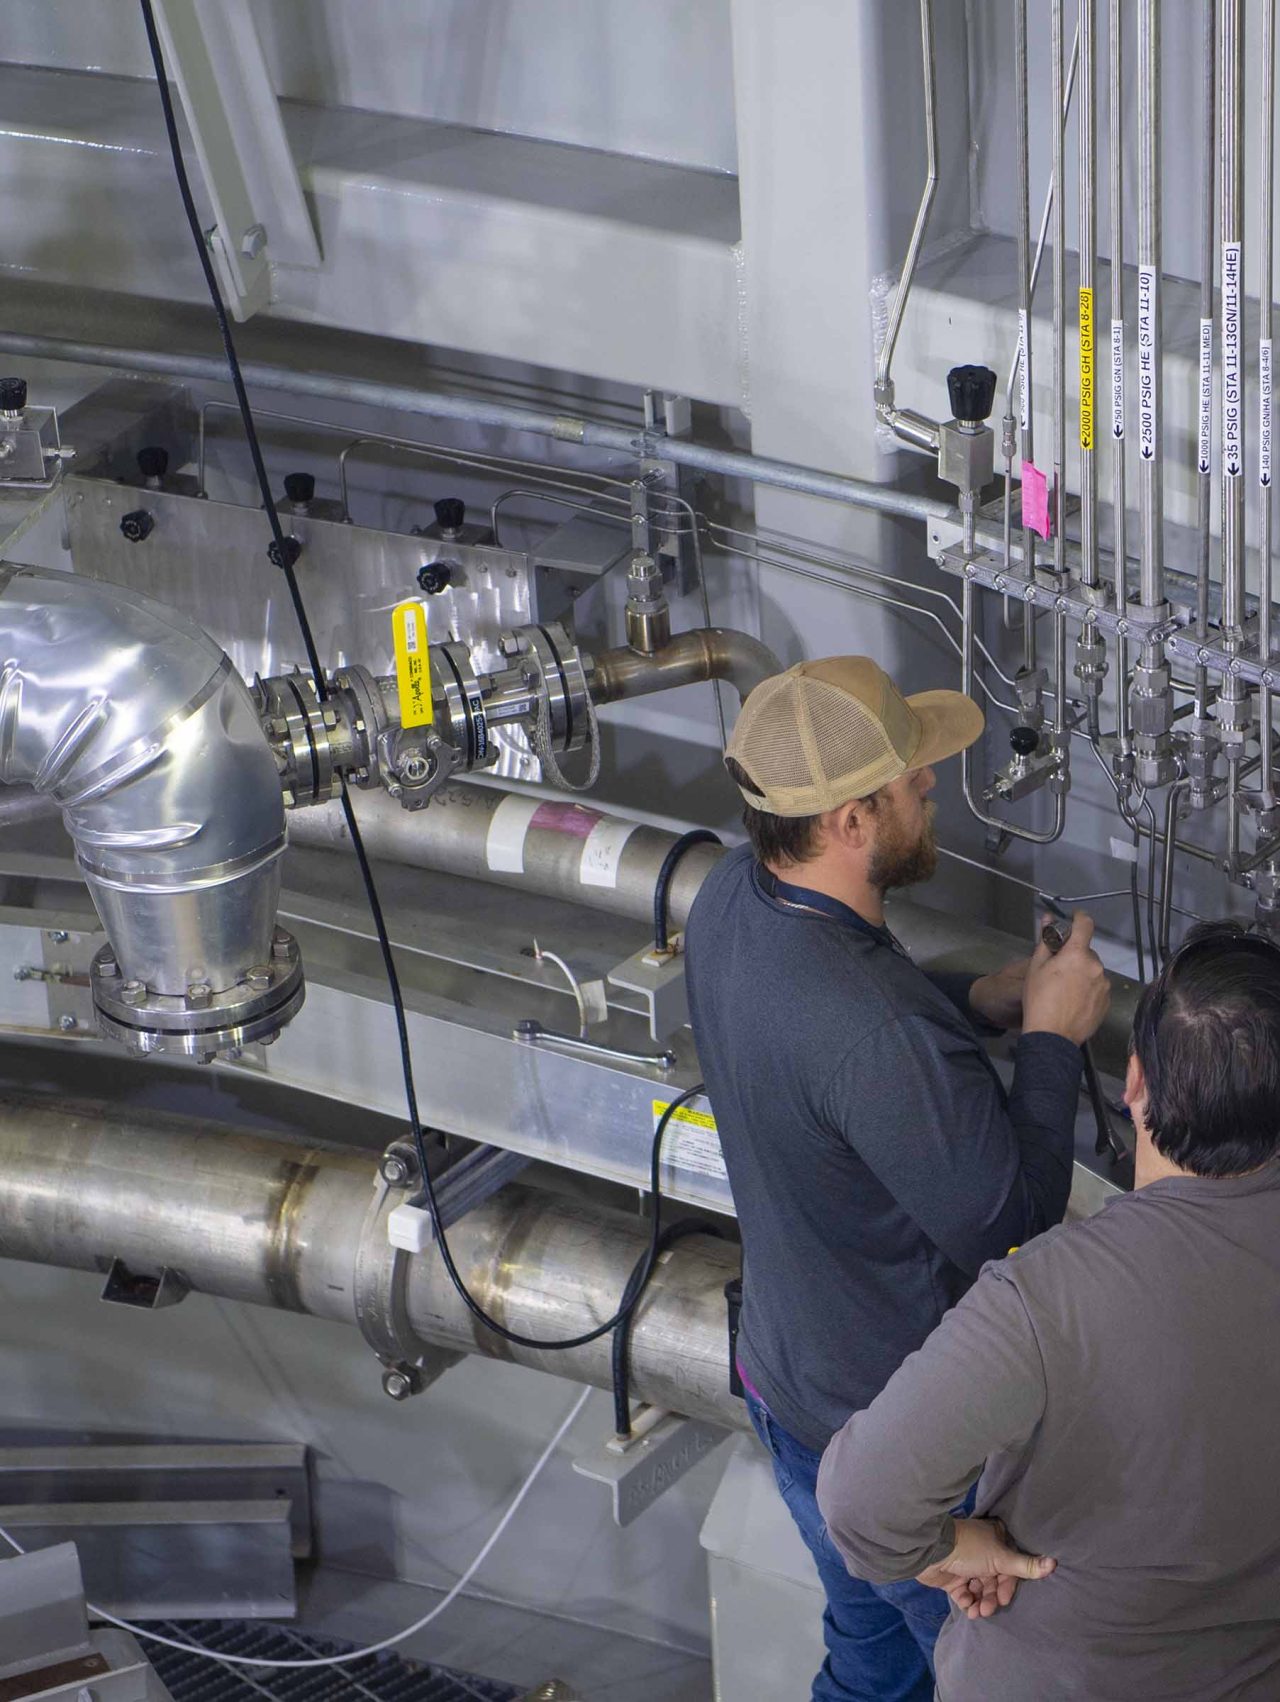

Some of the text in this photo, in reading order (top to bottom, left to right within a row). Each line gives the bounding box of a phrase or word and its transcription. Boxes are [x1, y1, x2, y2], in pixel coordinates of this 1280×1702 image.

[1080, 292, 1092, 437] 2000 PSIG GH (STA 8-28)
[1139, 272, 1152, 443] 2500 PSIG HE (STA 11-10)
[1225, 248, 1240, 460] 35 PSIG (STA 11-13GN/11-14HE)
[1113, 326, 1122, 424] 750 PSIG GN (STA 8-1)
[1262, 374, 1272, 395] (STA
[1201, 376, 1211, 397] (STA
[1201, 400, 1209, 412] HE
[1262, 398, 1271, 427] GN/HA
[1201, 415, 1209, 437] PSIG
[1201, 439, 1209, 459] 1000
[1262, 430, 1270, 452] PSIG
[1262, 455, 1270, 470] 140
